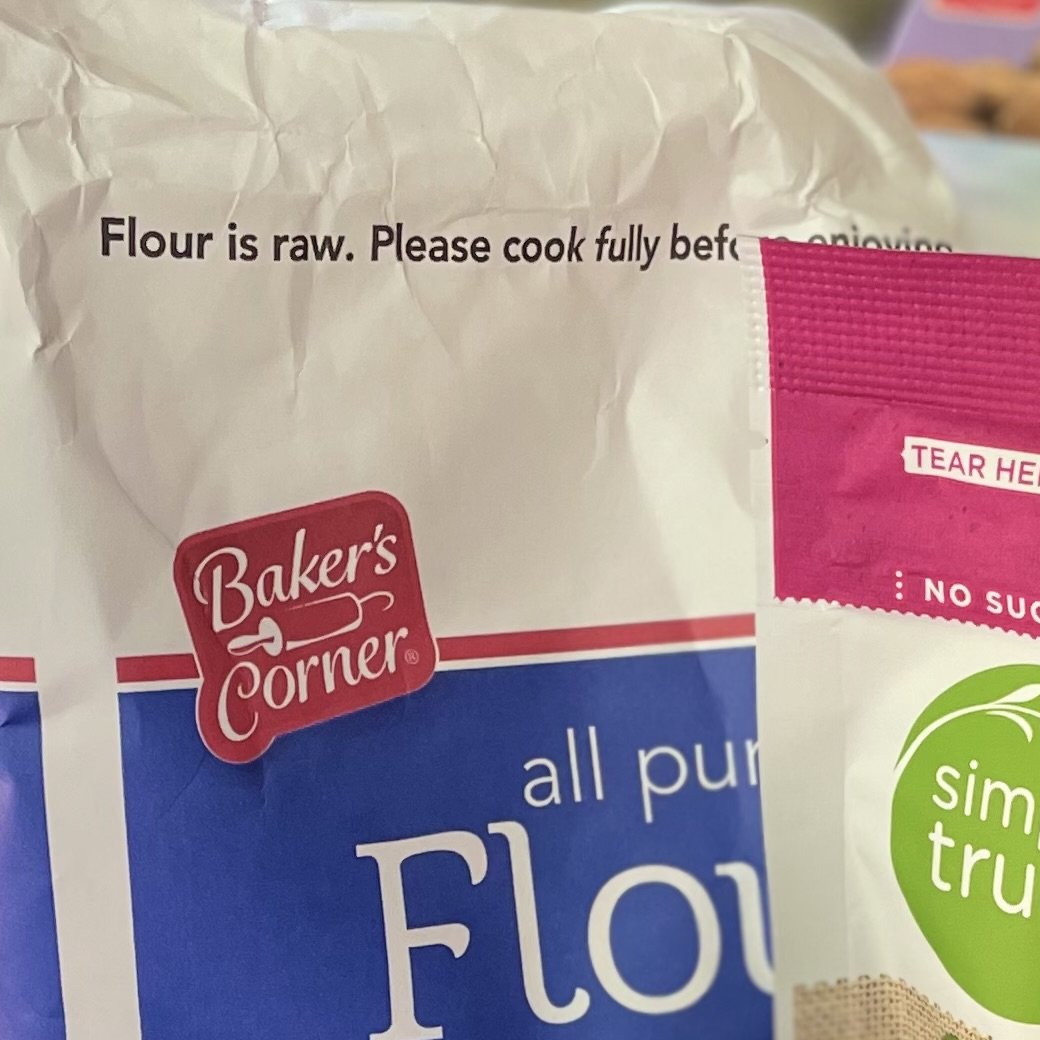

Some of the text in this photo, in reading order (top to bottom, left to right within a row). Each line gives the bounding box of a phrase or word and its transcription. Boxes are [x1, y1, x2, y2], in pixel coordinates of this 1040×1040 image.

[101, 217, 213, 260] Flour
[227, 223, 258, 260] is
[272, 232, 355, 262] raw.
[371, 224, 491, 262] Please
[503, 227, 586, 262] cook
[595, 225, 660, 270] fully
[669, 222, 740, 261] bef
[911, 444, 985, 480] TEAR
[193, 523, 397, 632] Baker's
[924, 577, 972, 607] NO
[523, 726, 760, 823] all pur
